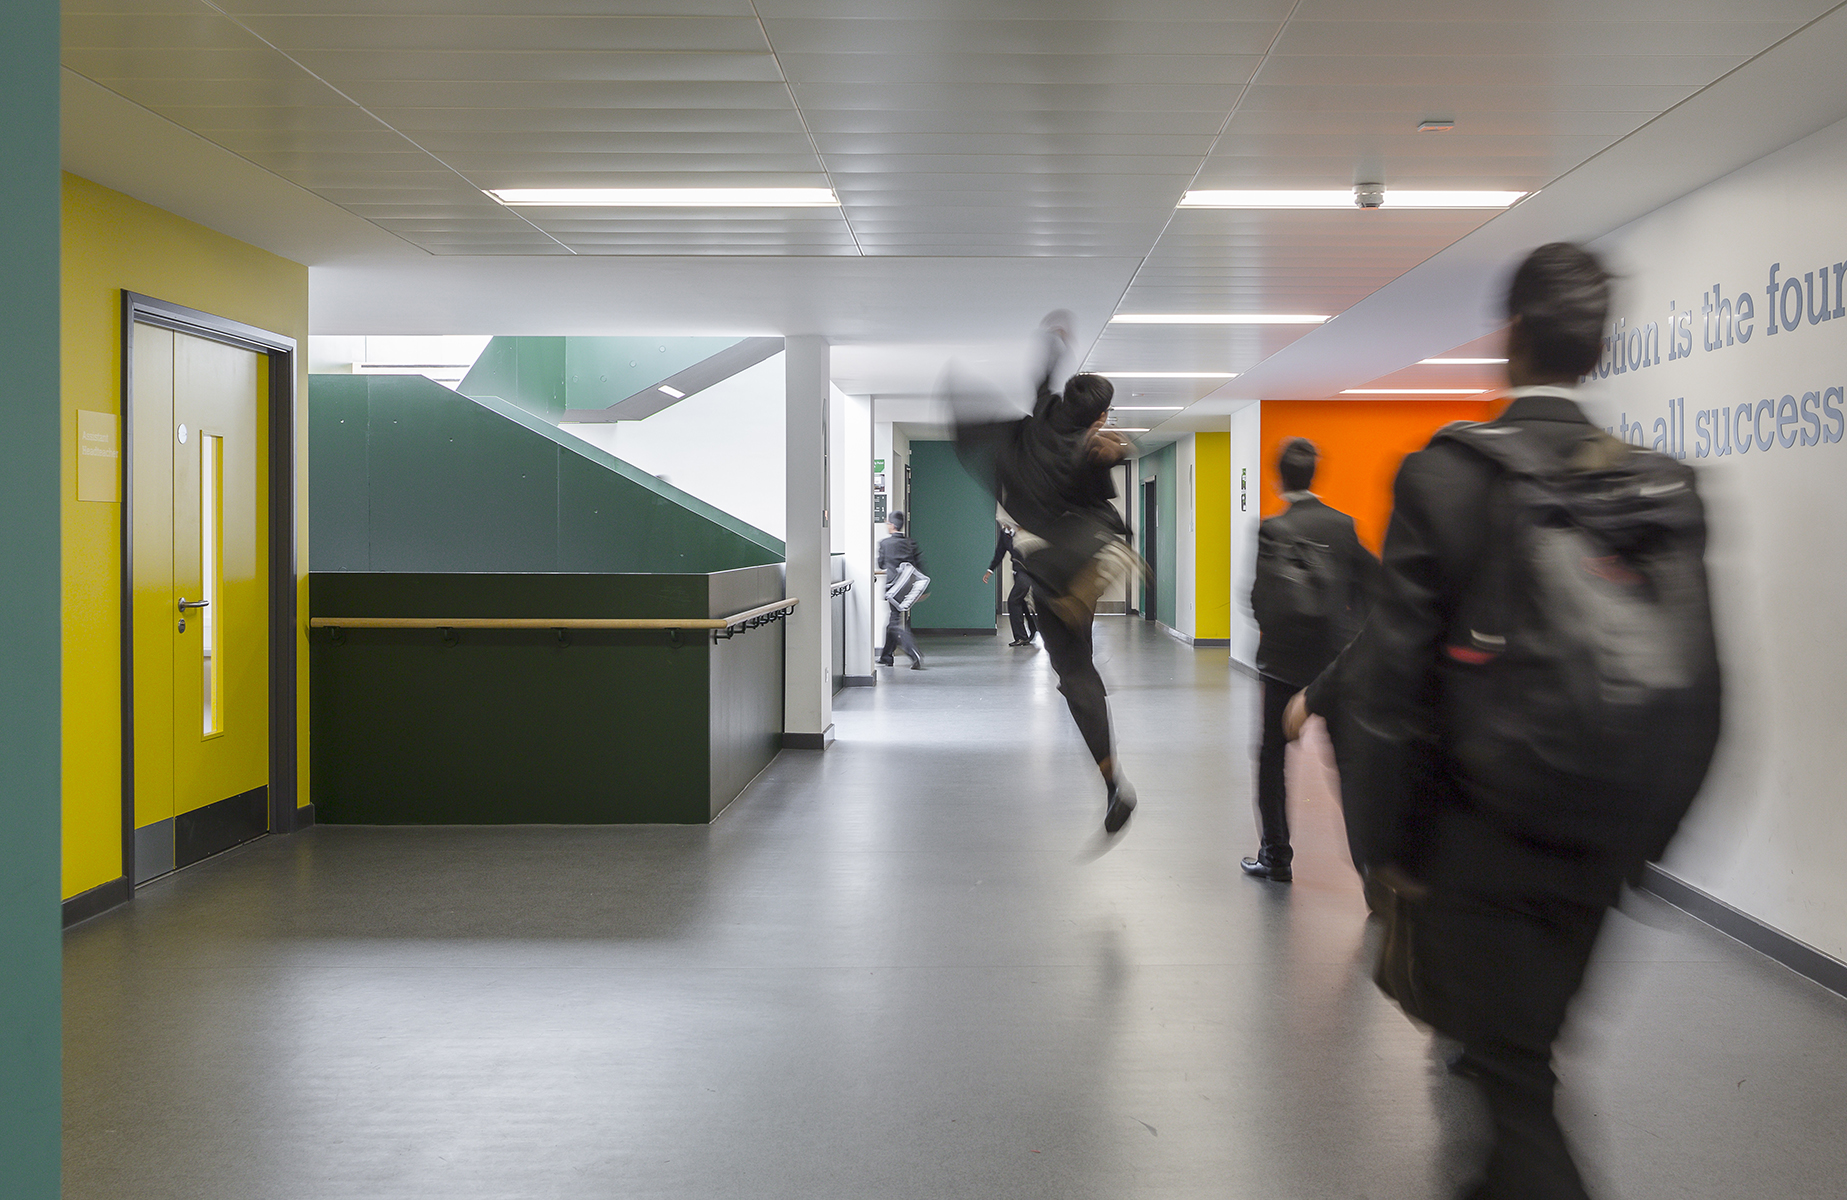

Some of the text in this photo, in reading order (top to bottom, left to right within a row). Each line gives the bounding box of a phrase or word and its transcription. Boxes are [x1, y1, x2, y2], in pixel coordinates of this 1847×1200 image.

[1581, 317, 1661, 384] ction
[1668, 300, 1692, 361] is
[1701, 283, 1754, 352] the
[1620, 386, 1845, 460] to all success
